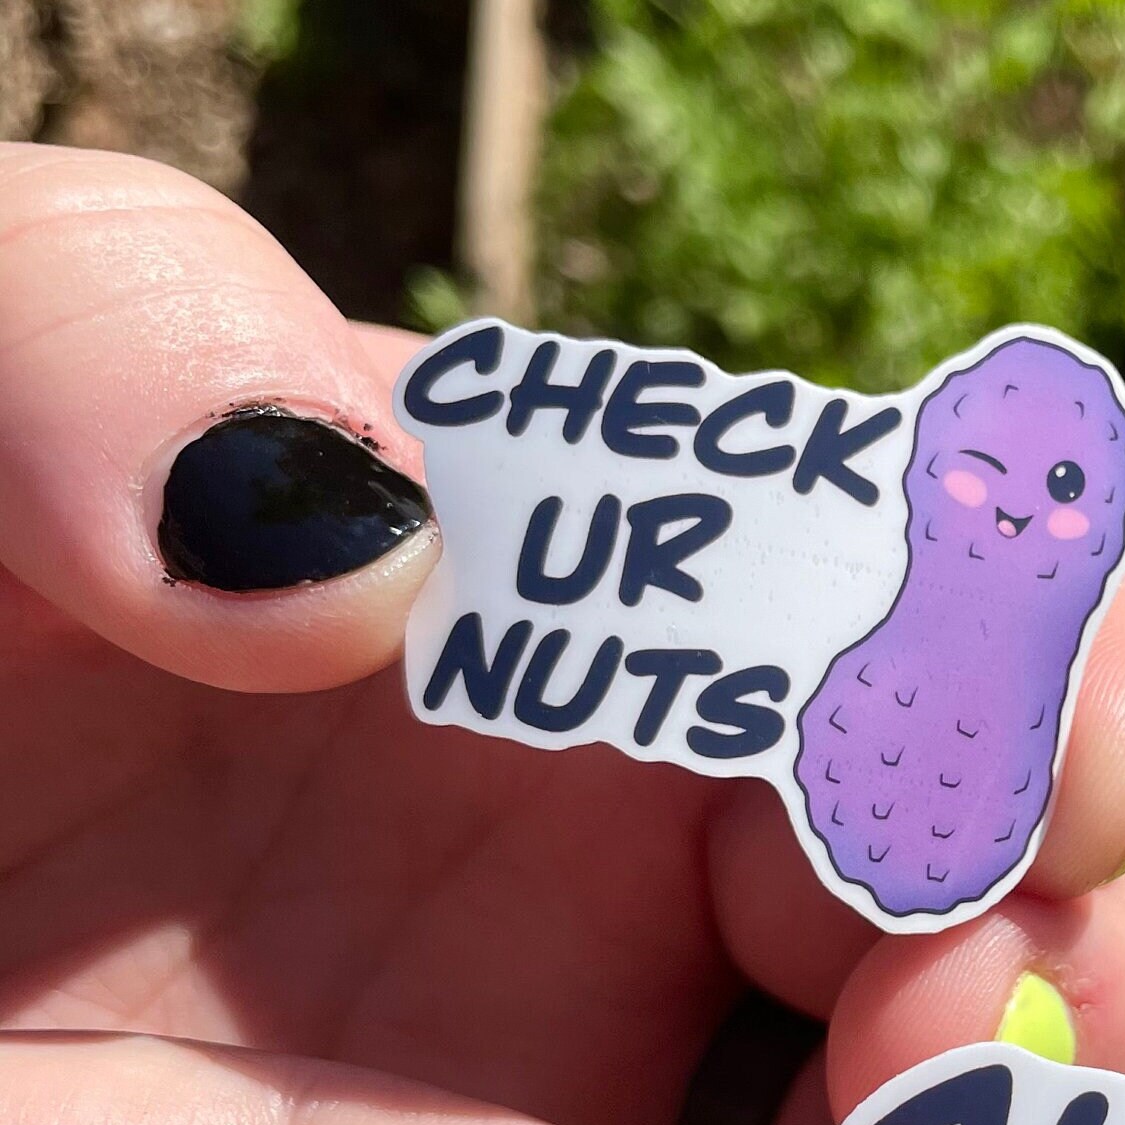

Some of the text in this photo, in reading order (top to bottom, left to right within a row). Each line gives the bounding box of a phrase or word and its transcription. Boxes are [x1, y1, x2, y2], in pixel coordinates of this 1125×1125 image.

[404, 326, 901, 506] CHECK
[516, 493, 732, 606] UR
[423, 612, 790, 759] NUTS
